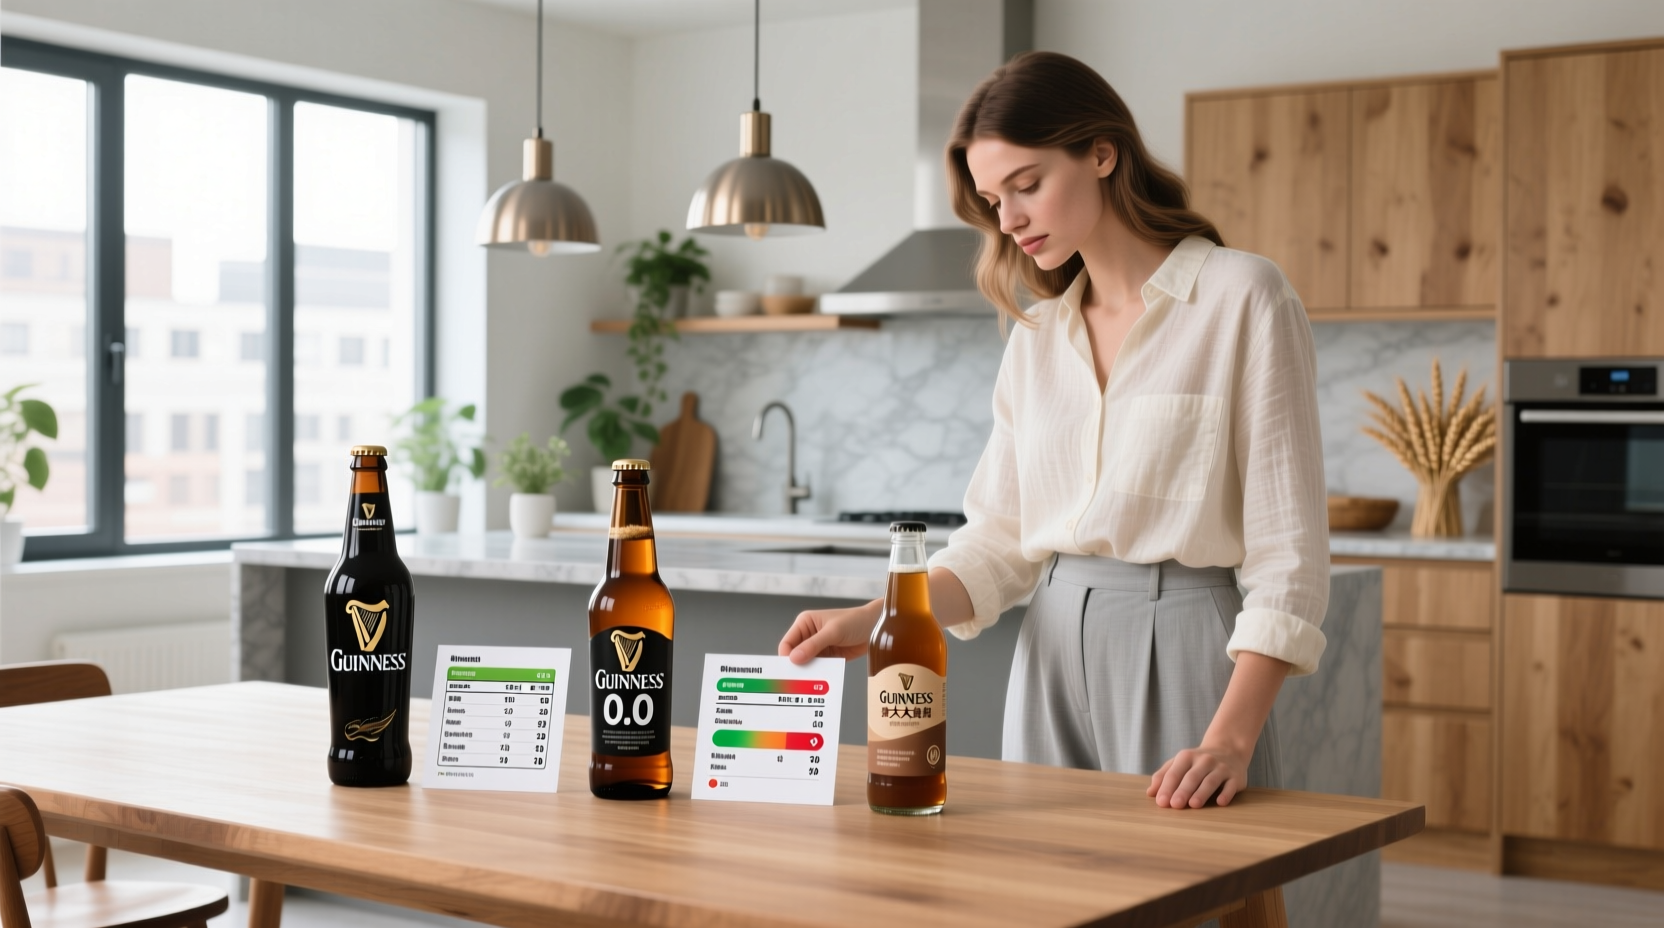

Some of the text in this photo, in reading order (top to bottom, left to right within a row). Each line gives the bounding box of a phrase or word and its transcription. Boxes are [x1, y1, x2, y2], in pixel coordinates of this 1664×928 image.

[330, 648, 407, 672] GUINNESS
[595, 668, 665, 690] GUINNESS
[879, 690, 934, 705] GUINNESS
[603, 693, 654, 726] 0.0
